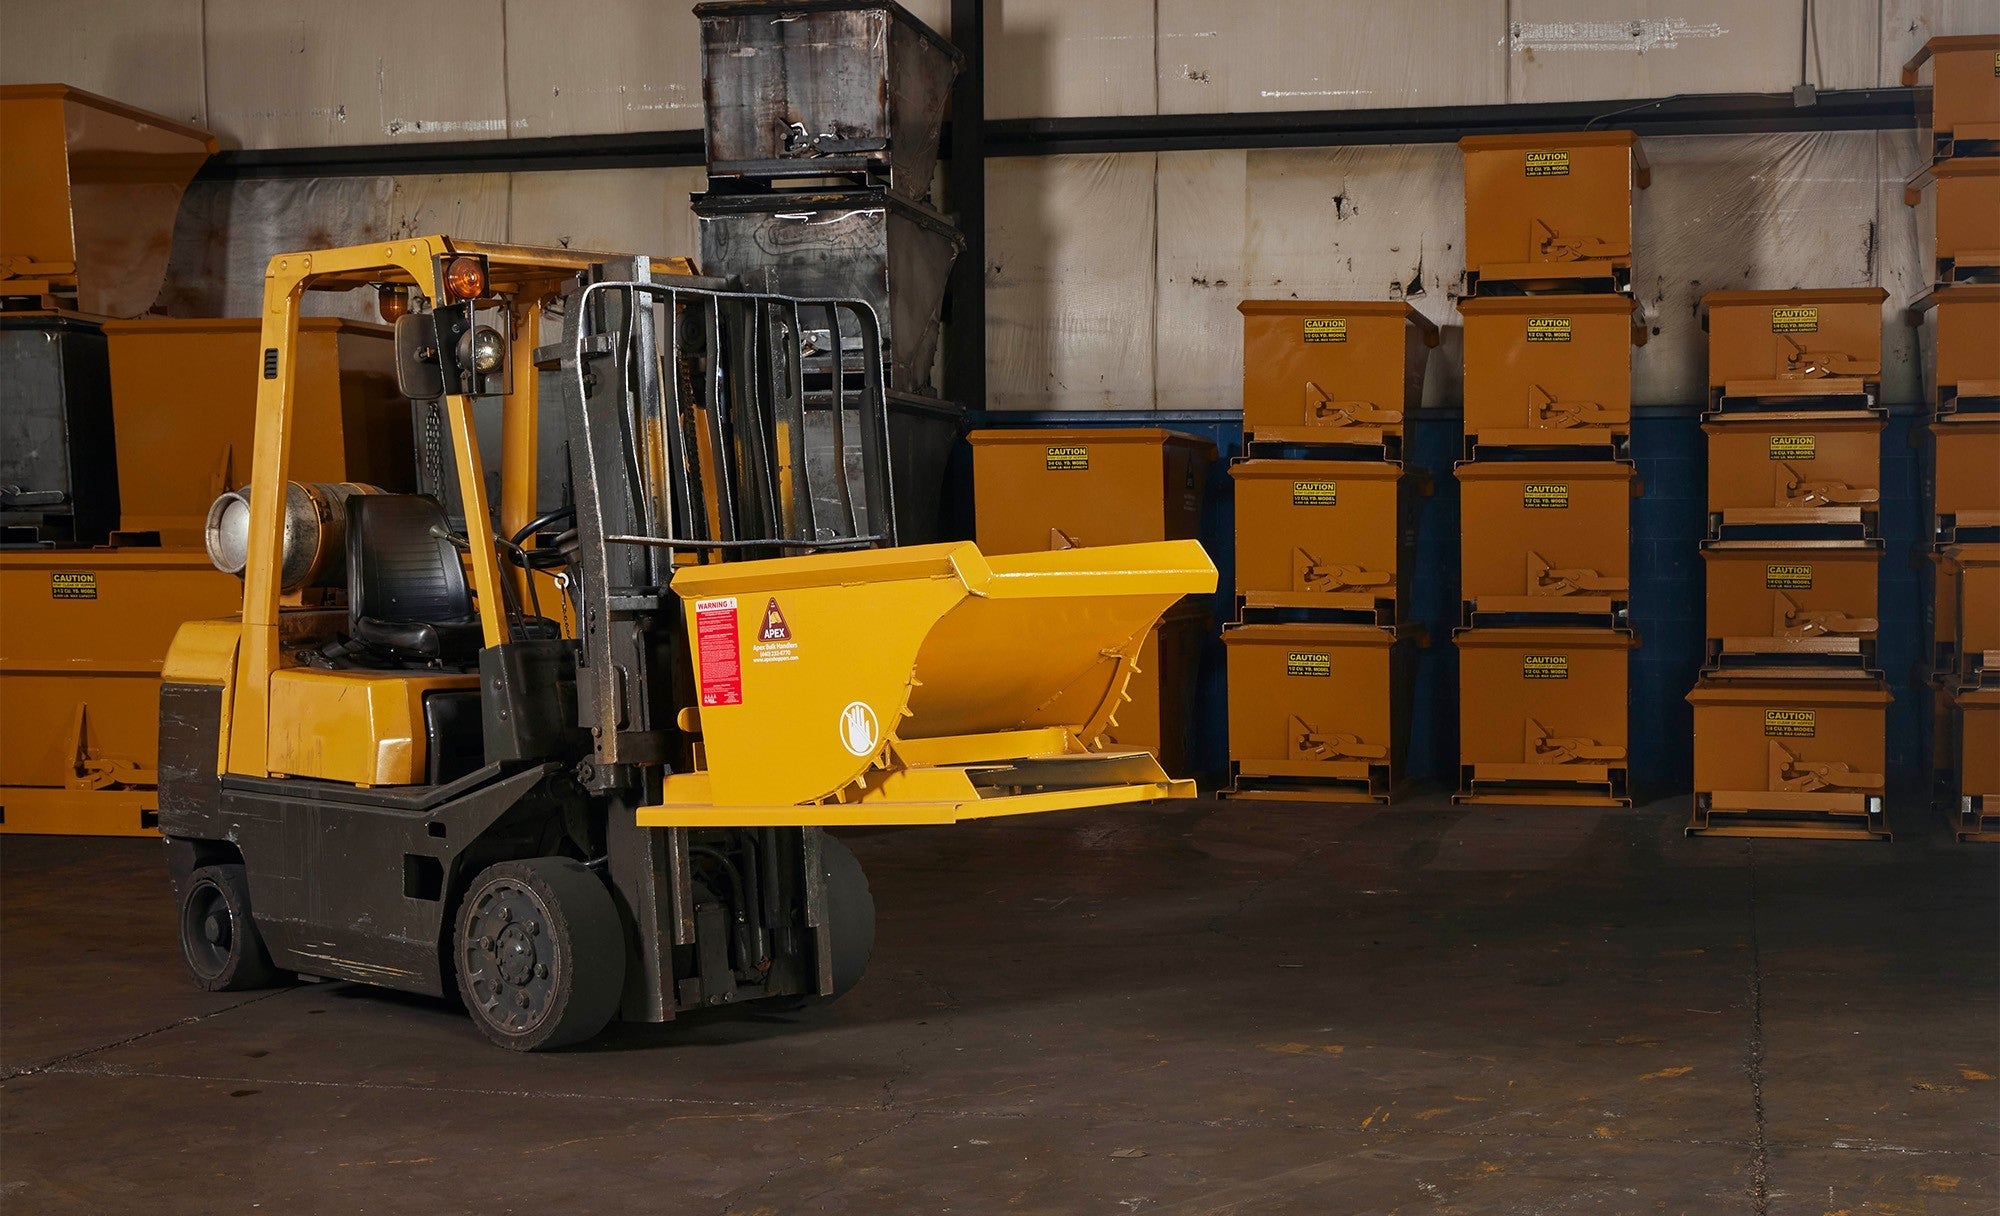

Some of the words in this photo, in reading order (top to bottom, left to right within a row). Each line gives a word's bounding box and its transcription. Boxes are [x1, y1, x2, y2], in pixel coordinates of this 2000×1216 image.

[698, 601, 728, 610] WARNING
[764, 628, 785, 639] APEX
[1768, 712, 1812, 720] CAUTION
